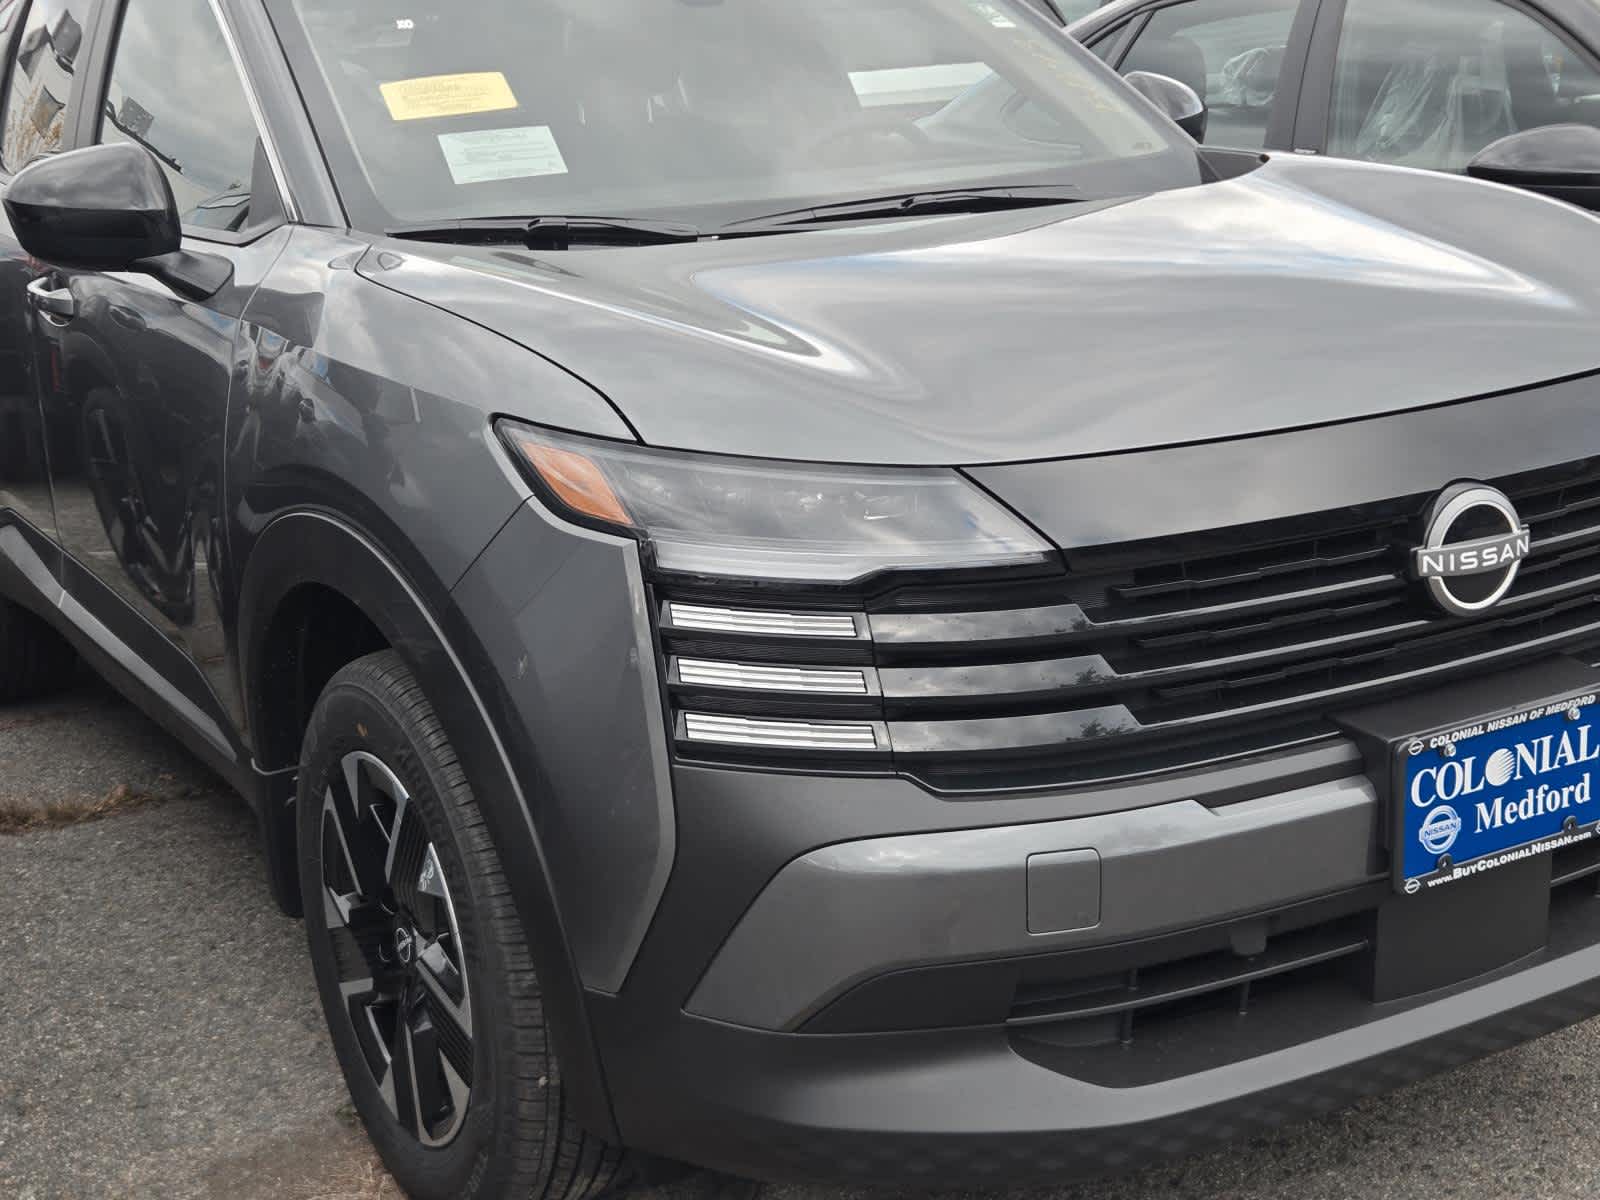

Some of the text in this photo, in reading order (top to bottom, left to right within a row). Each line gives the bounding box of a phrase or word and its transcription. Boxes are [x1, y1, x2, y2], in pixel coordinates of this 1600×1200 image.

[1422, 535, 1530, 574] NISSAN
[1430, 694, 1597, 748] COLONIAL NISSAN OF MEDFORD
[1411, 725, 1600, 807] COLONIAL
[1424, 821, 1458, 838] NISSAN
[1474, 772, 1592, 834] Medford
